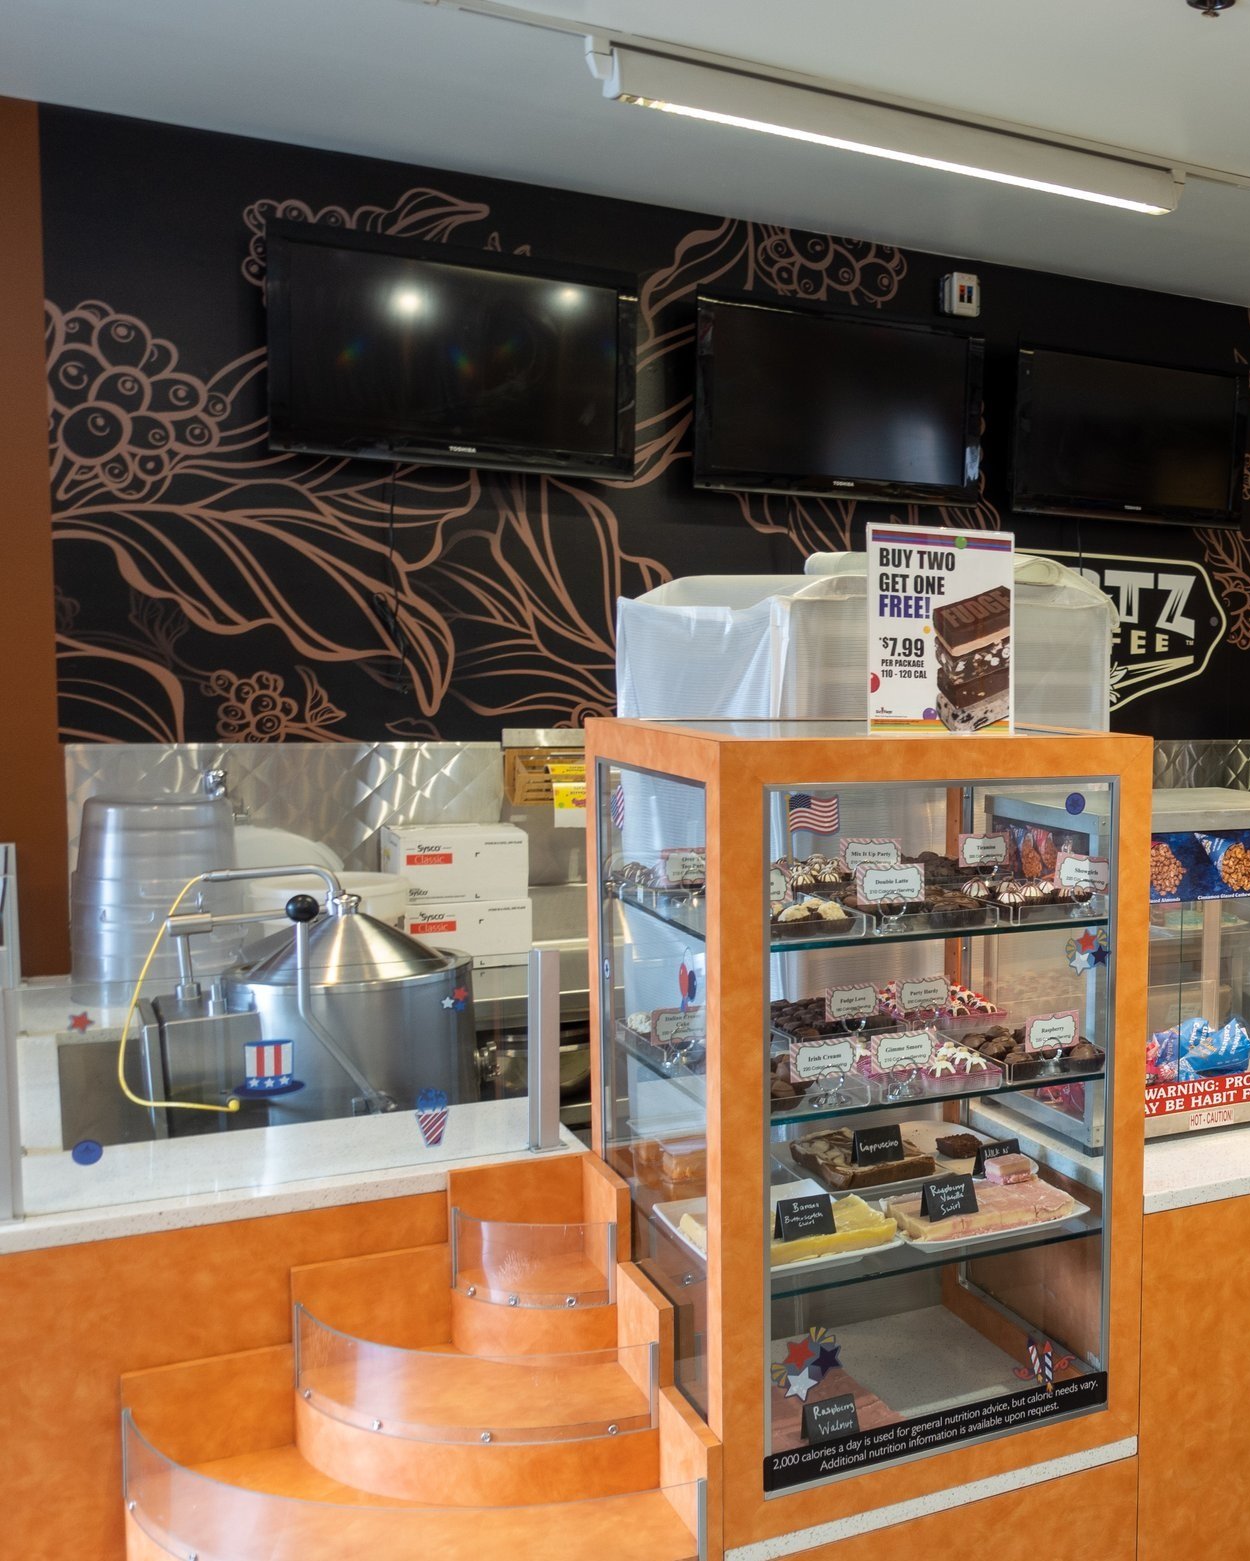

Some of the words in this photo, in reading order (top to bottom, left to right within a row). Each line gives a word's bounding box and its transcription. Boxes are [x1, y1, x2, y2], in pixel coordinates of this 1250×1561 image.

[879, 547, 915, 568] BUY
[917, 551, 956, 572] TWO
[879, 573, 909, 593] GET
[914, 574, 945, 595] ONE
[879, 595, 930, 619] FREE!
[881, 659, 893, 668] PER
[894, 660, 925, 669] PACKAGE
[881, 669, 893, 678] 110
[899, 670, 912, 679] 120
[914, 670, 928, 679] CAL
[416, 844, 442, 854] Sysco
[414, 854, 445, 864] Classic
[420, 912, 446, 922] Sysco
[418, 922, 449, 933] Classic
[885, 1045, 905, 1053] Gimme
[906, 1043, 923, 1051] Smore
[808, 1054, 821, 1062] Irish
[822, 1053, 842, 1061] Cream
[1144, 1079, 1220, 1101] WARNING:
[1144, 1099, 1159, 1116] AY
[1165, 1096, 1185, 1112] BE
[1190, 1090, 1235, 1109] HABIT
[772, 1454, 800, 1470] 2,000
[801, 1447, 837, 1463] calories
[845, 1439, 862, 1452] day
[864, 1437, 871, 1446] is
[873, 1429, 894, 1444] used
[896, 1426, 909, 1437] for
[911, 1417, 943, 1437] general
[944, 1408, 980, 1425] nutrition
[981, 1402, 1010, 1416] advice,
[1011, 1397, 1025, 1408] but
[1027, 1391, 1053, 1404] calorie
[1055, 1384, 1078, 1397] needs
[1079, 1379, 1099, 1391] vary.
[818, 1420, 853, 1436] Walnut
[819, 1451, 867, 1472] Additional
[868, 1442, 907, 1459] nutrition
[908, 1428, 958, 1448] information
[959, 1426, 966, 1435] is
[967, 1416, 1003, 1433] available
[1004, 1411, 1026, 1425] upon
[1027, 1402, 1060, 1419] request.
